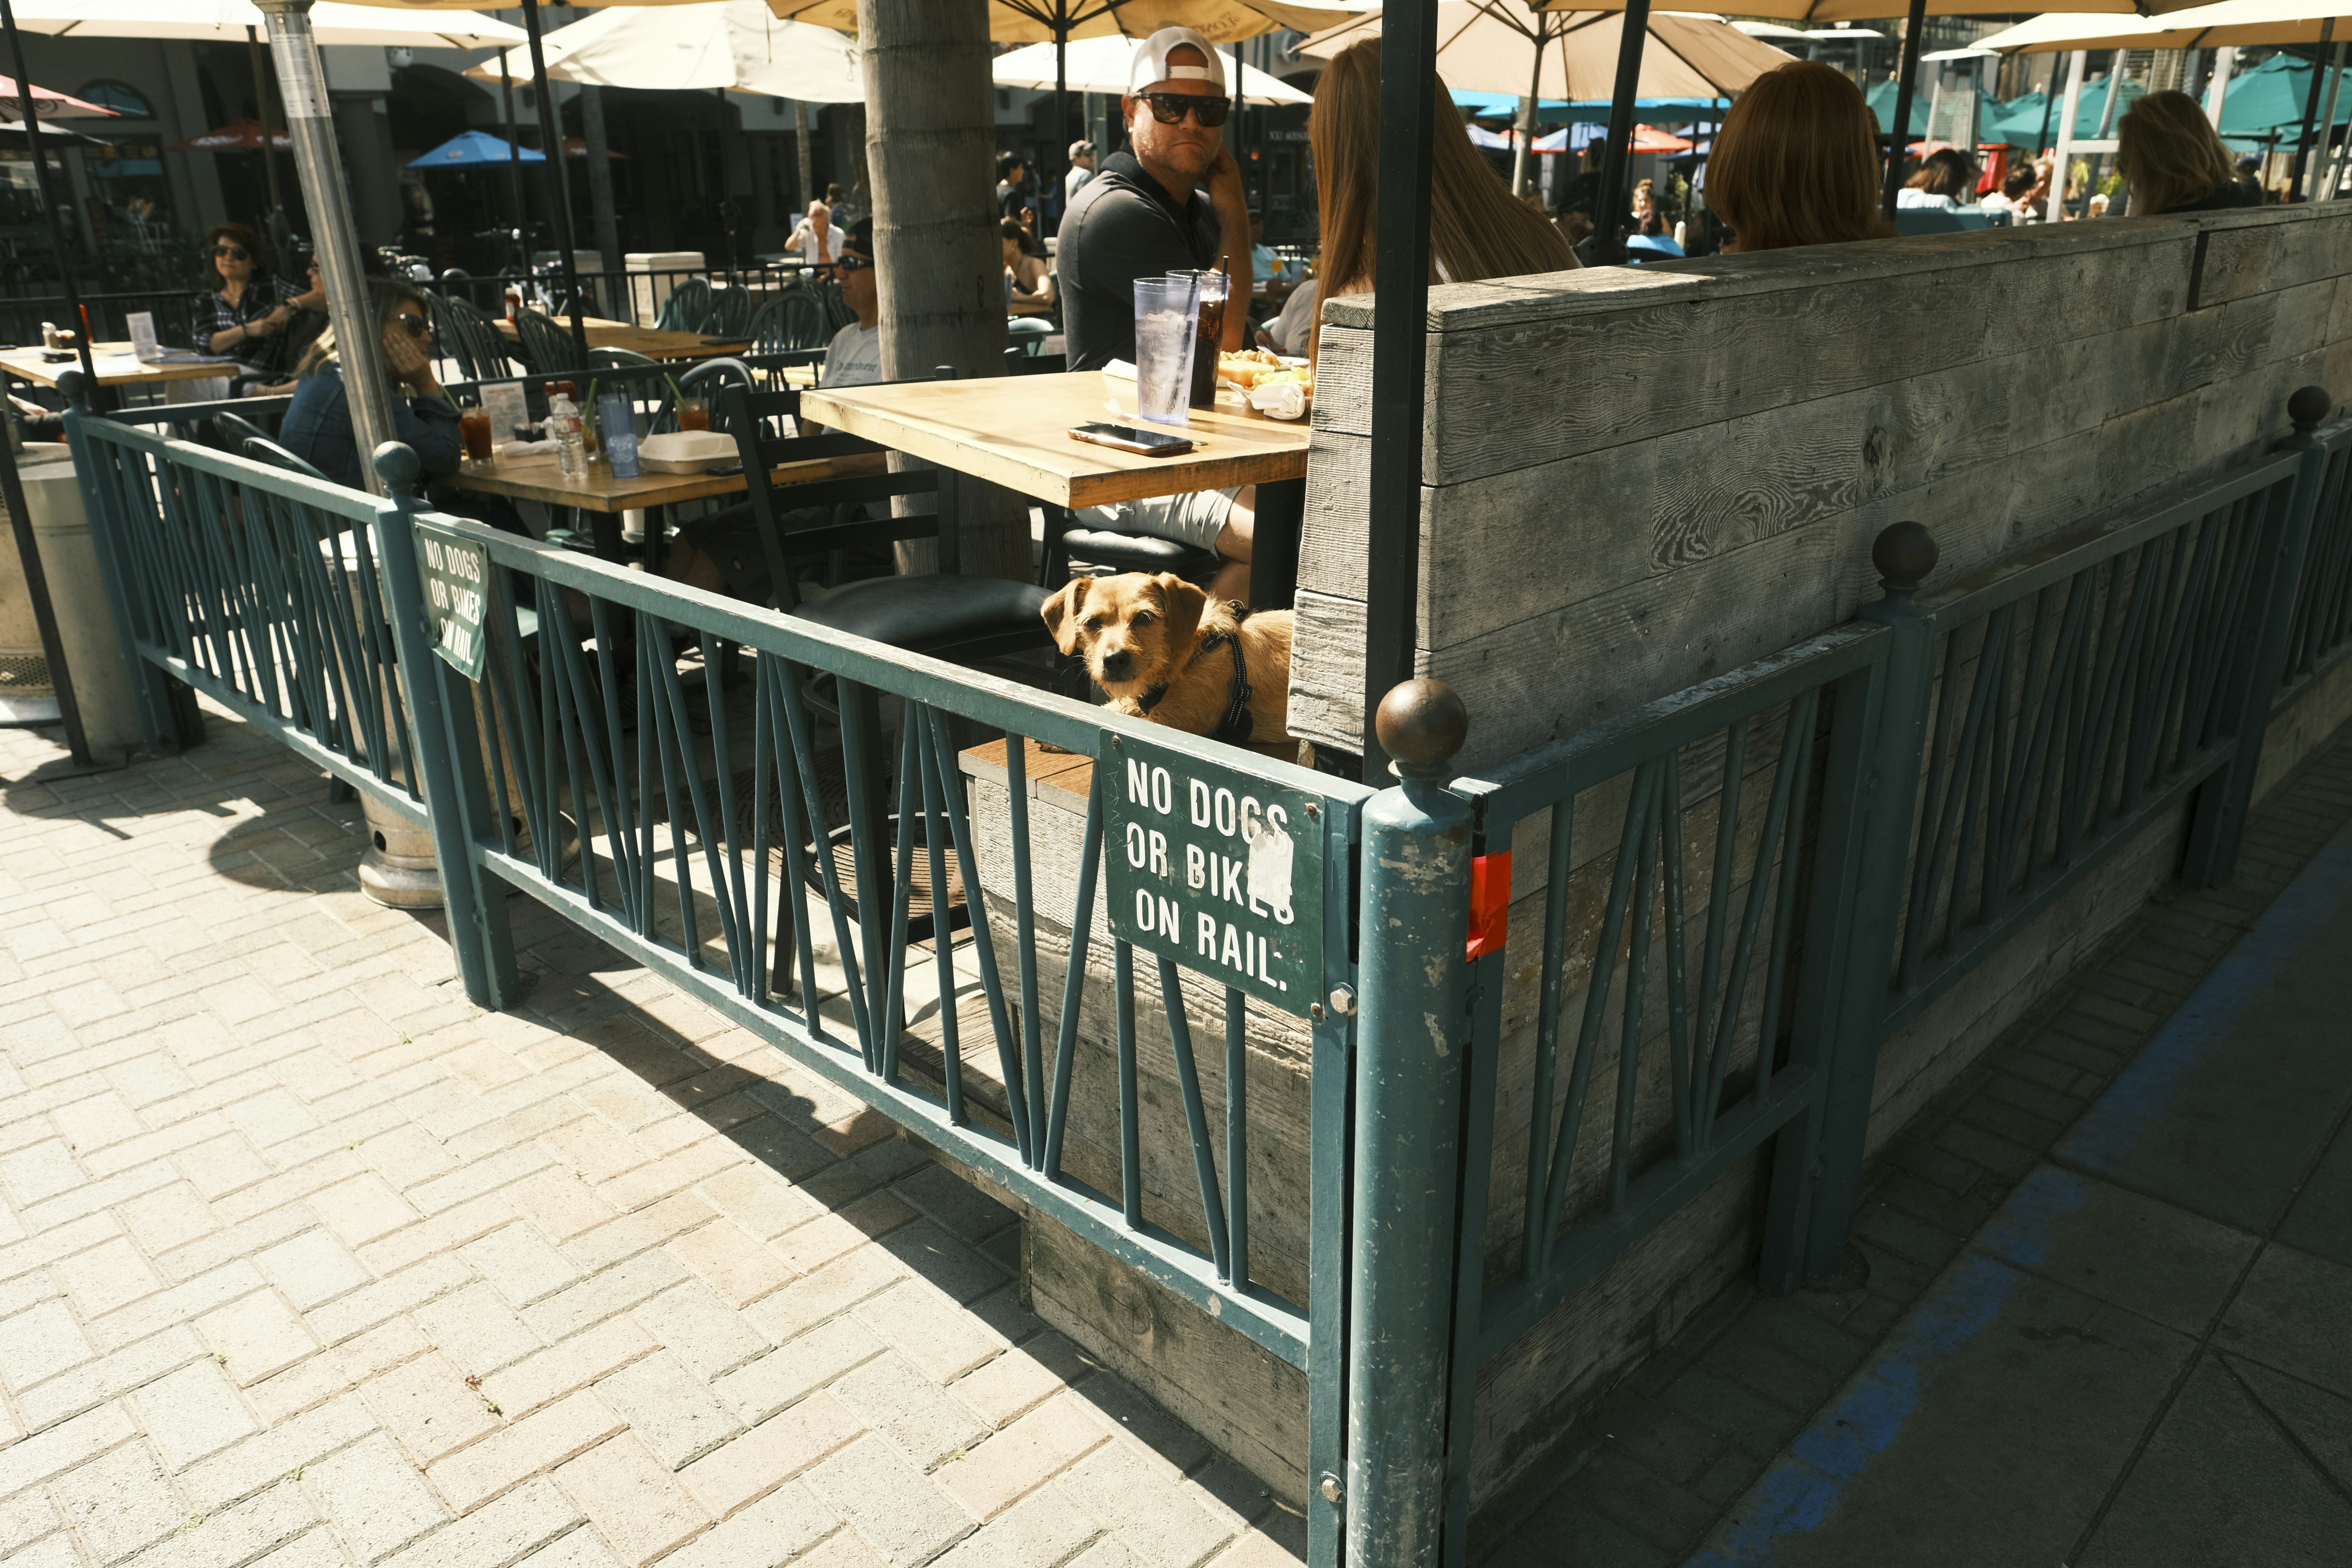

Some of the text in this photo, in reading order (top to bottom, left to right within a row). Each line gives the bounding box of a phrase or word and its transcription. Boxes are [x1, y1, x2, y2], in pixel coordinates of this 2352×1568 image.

[424, 538, 480, 583] NO DOGS
[430, 578, 481, 626] OR BIKES
[440, 617, 455, 651] ON
[1128, 758, 1171, 815] NO
[1191, 778, 1288, 850] DOGS
[1127, 822, 1168, 877] OR
[1136, 888, 1286, 991] ON RAIL.
